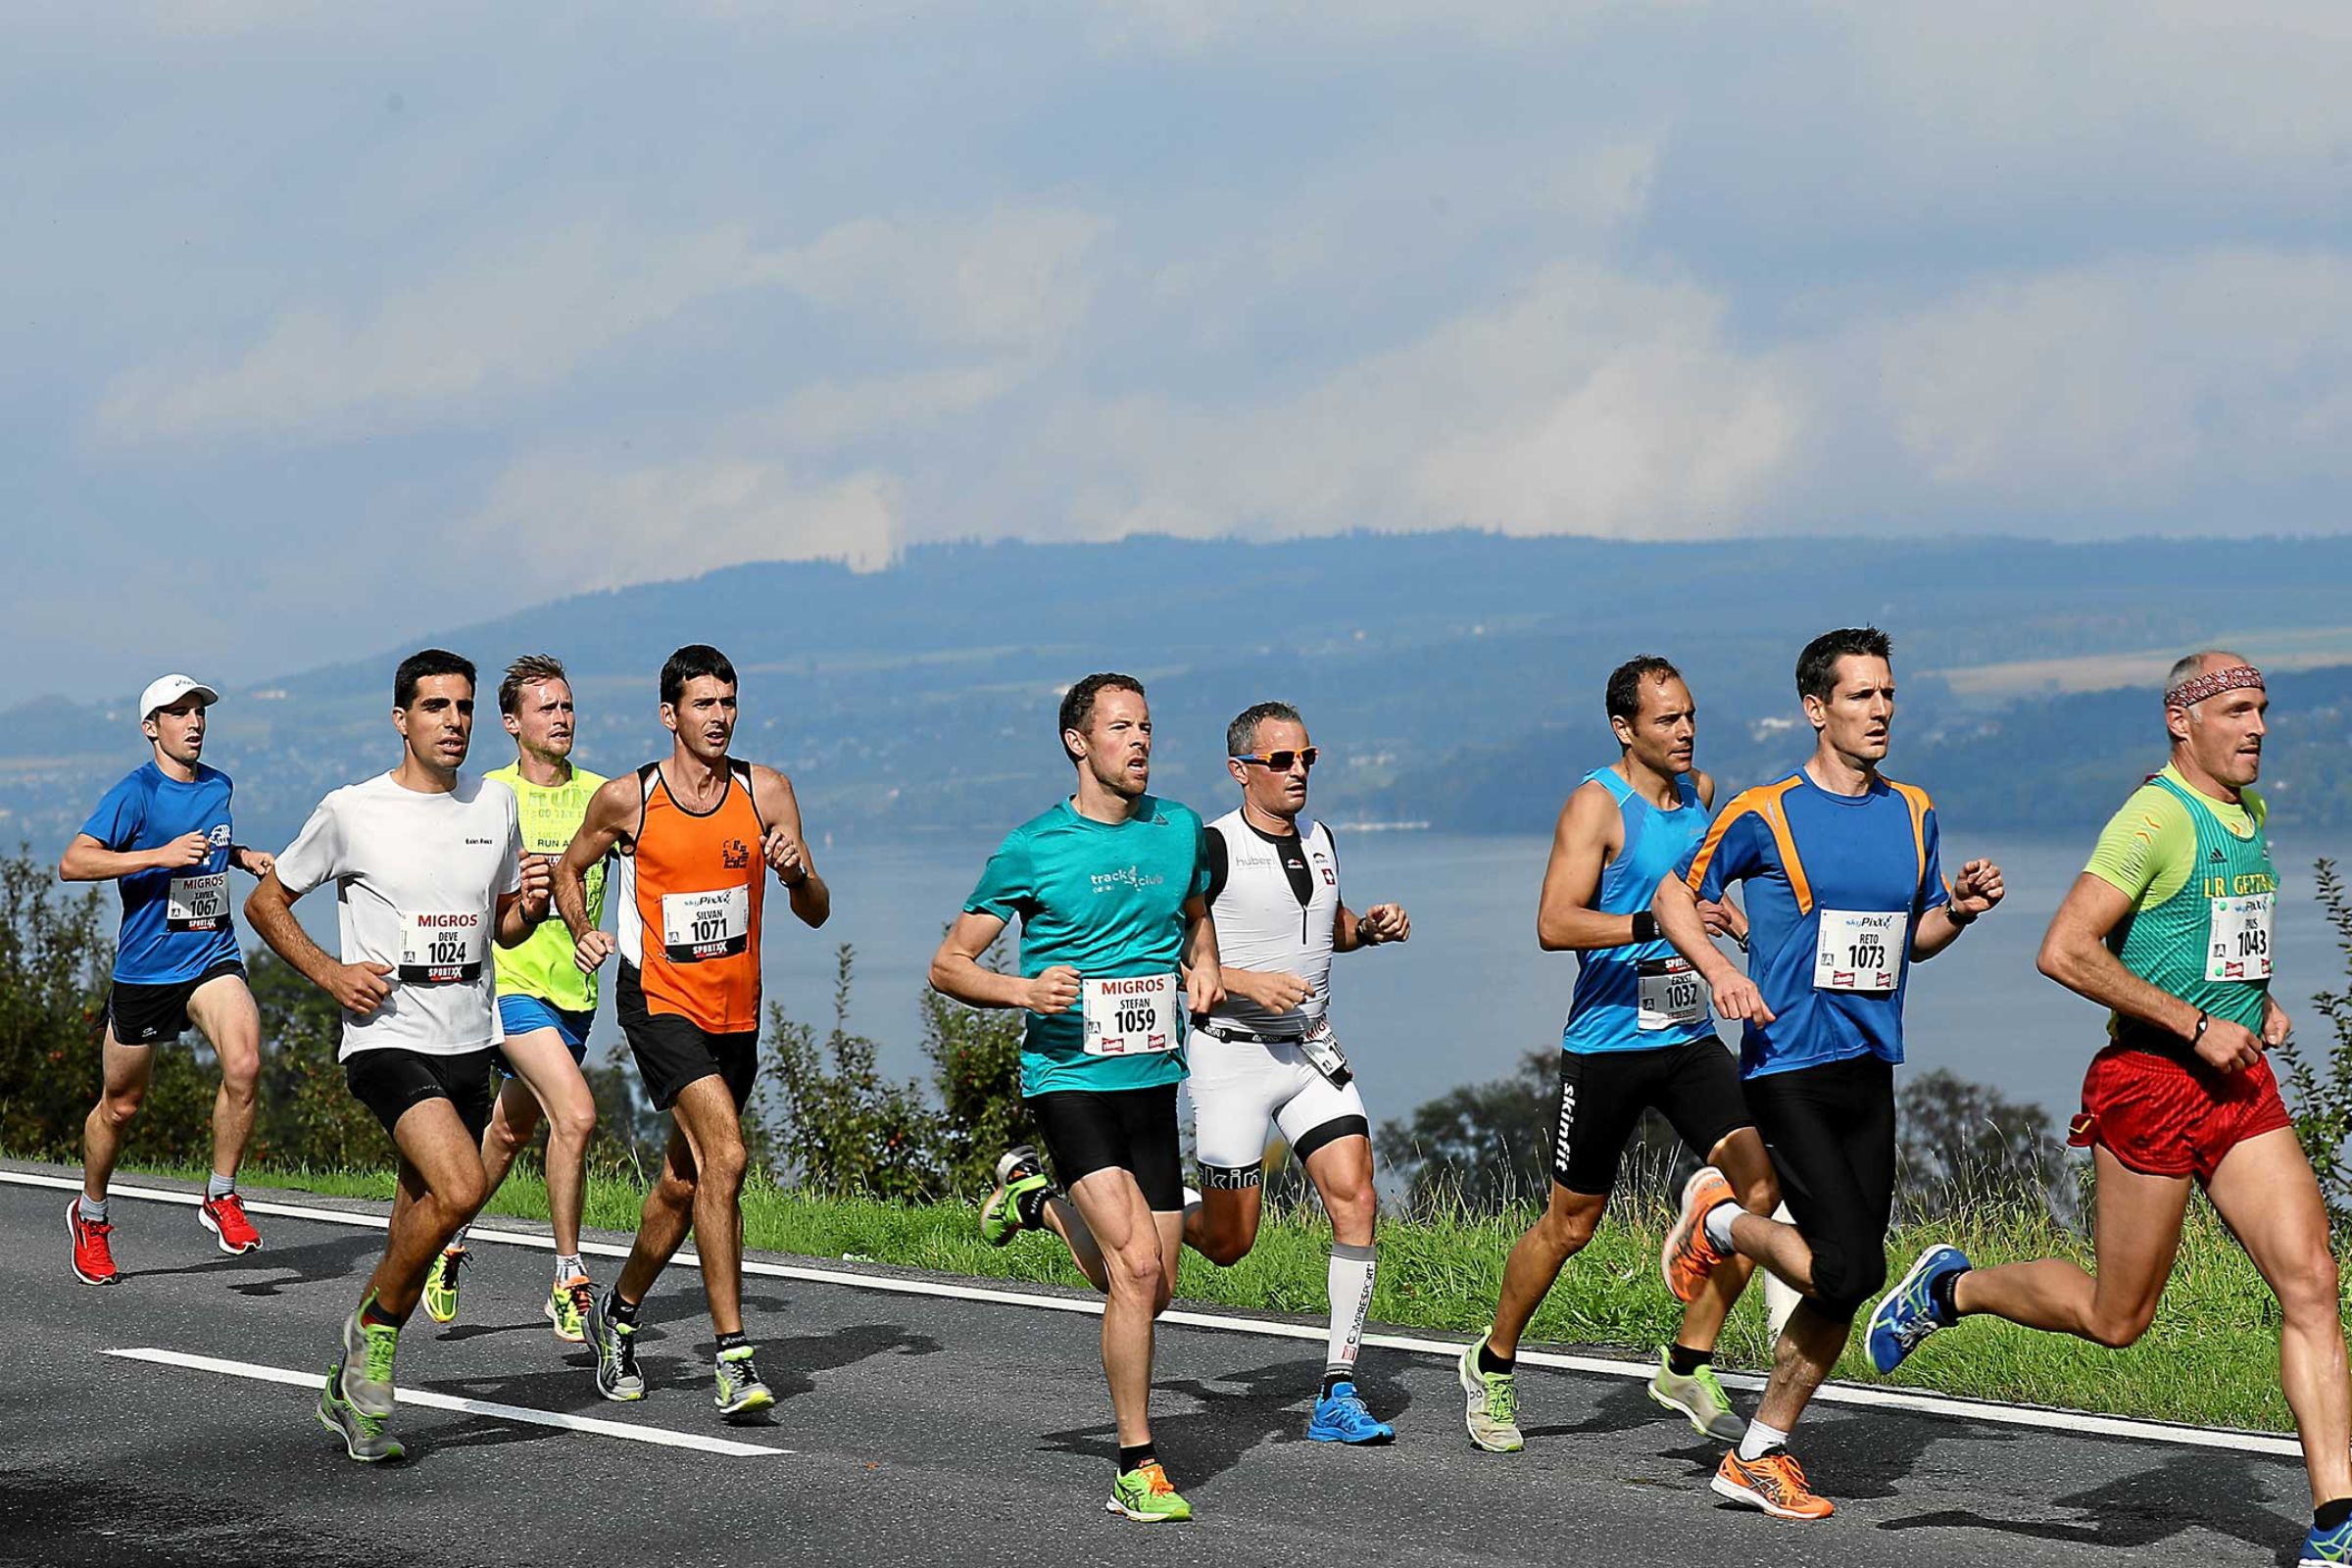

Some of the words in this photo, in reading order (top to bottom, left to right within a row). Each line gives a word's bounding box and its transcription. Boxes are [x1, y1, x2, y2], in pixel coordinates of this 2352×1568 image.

[537, 839, 559, 848] RUN
[183, 875, 224, 891] MIGROS
[1091, 869, 1127, 885] track
[1138, 874, 1164, 886] club
[2204, 877, 2227, 899] LR
[189, 898, 219, 916] 1067
[696, 909, 723, 921] SILVAN
[417, 914, 478, 927] MIGROS
[438, 931, 459, 942] DEVE
[690, 918, 727, 942] 1071
[1859, 934, 1880, 944] RETO
[2238, 929, 2267, 956] 1043
[428, 941, 466, 963] 1024
[1848, 945, 1885, 968] 1073
[1102, 978, 1165, 995] MIGROS
[1120, 998, 1151, 1009] STEFAN
[1666, 983, 1697, 1008] 1032
[1114, 1008, 1156, 1033] 1059
[1555, 1082, 1577, 1172] skinfit
